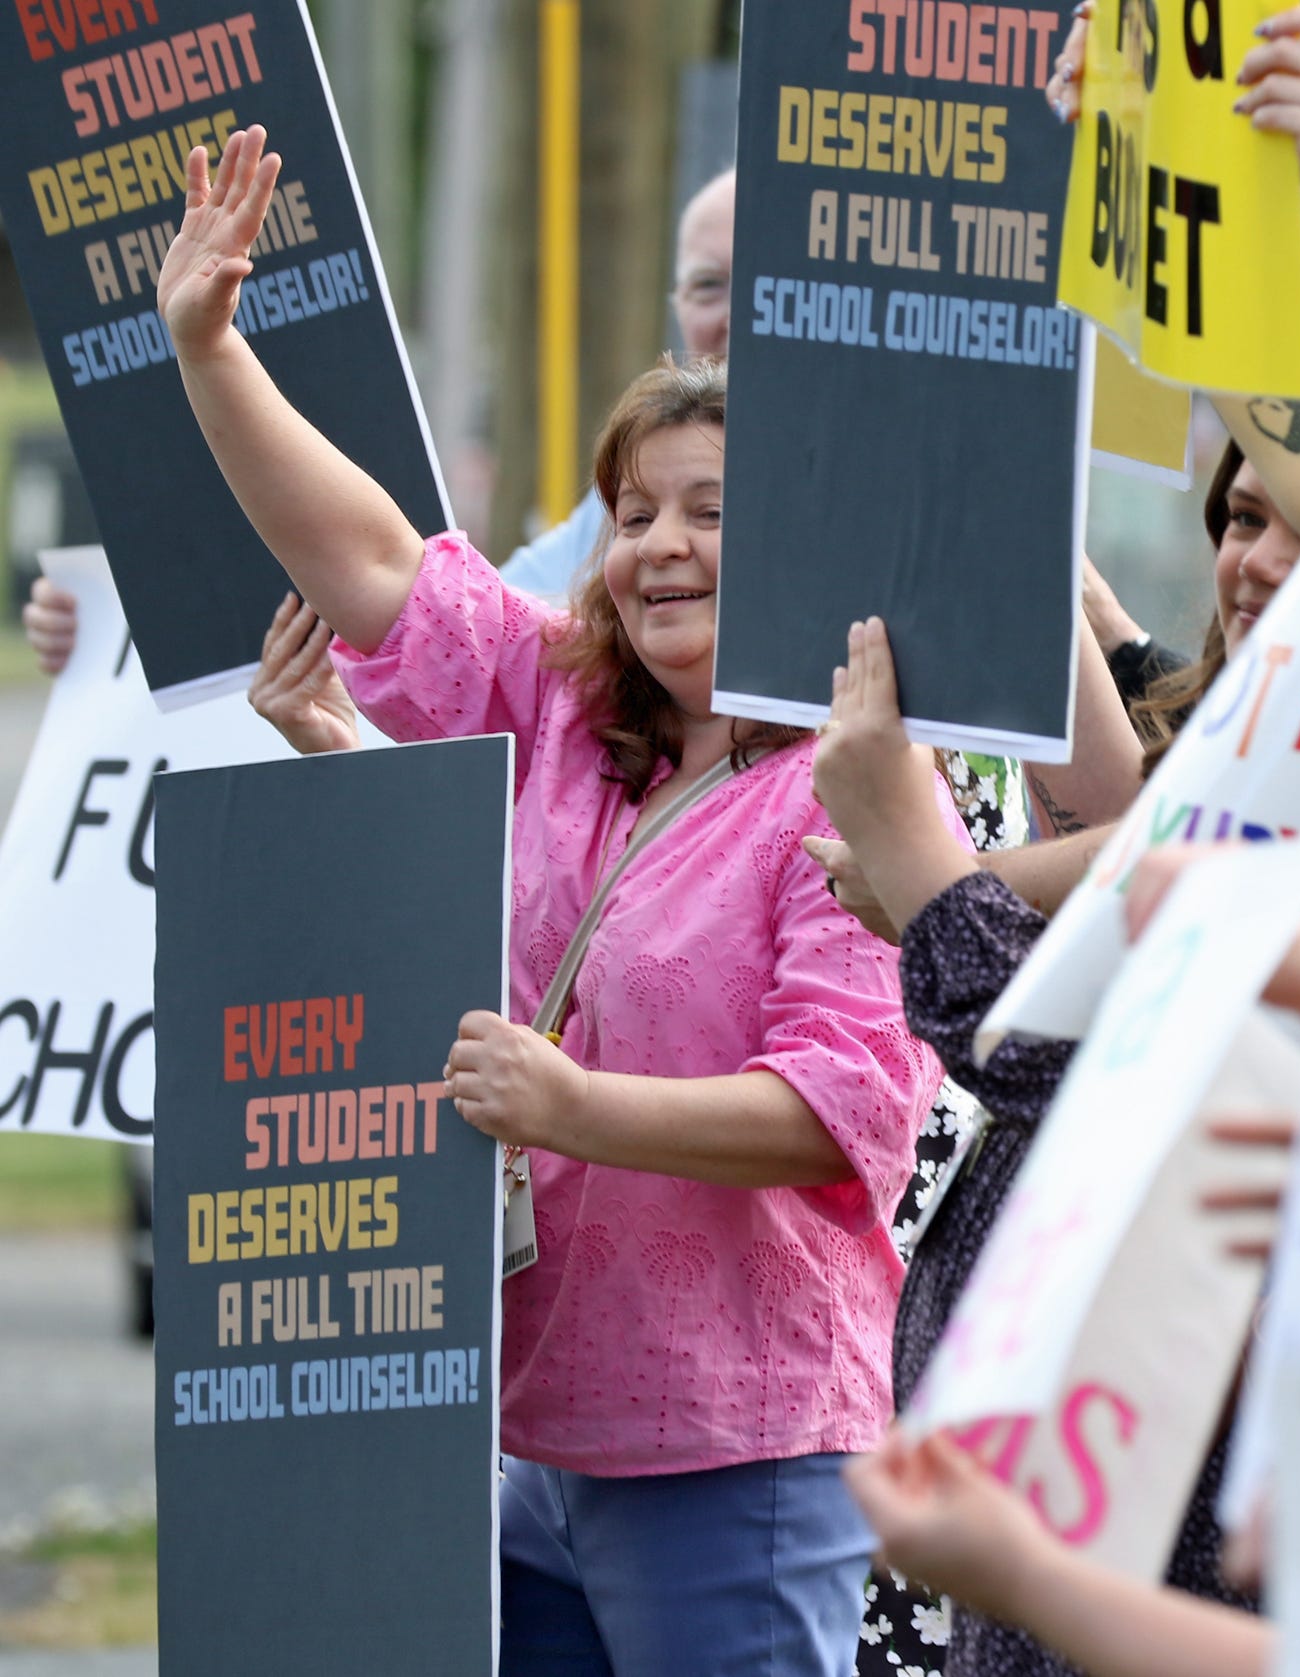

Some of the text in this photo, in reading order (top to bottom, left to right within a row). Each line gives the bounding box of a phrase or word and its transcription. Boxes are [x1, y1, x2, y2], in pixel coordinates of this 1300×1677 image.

[61, 12, 263, 138] STUDENT
[847, 0, 1059, 90] STUDENT
[777, 86, 1007, 184] DESERVES
[84, 239, 123, 306] A
[808, 189, 1048, 283] A FULL TIME
[752, 275, 1079, 370] SCHOOL COUNSELOR!
[223, 993, 365, 1082] EVERY
[245, 1081, 447, 1170] STUDENT
[187, 1176, 399, 1264] DESERVES
[218, 1265, 444, 1347] A FULL TIME
[174, 1348, 480, 1426] SCHOOL COUNSELOR!
